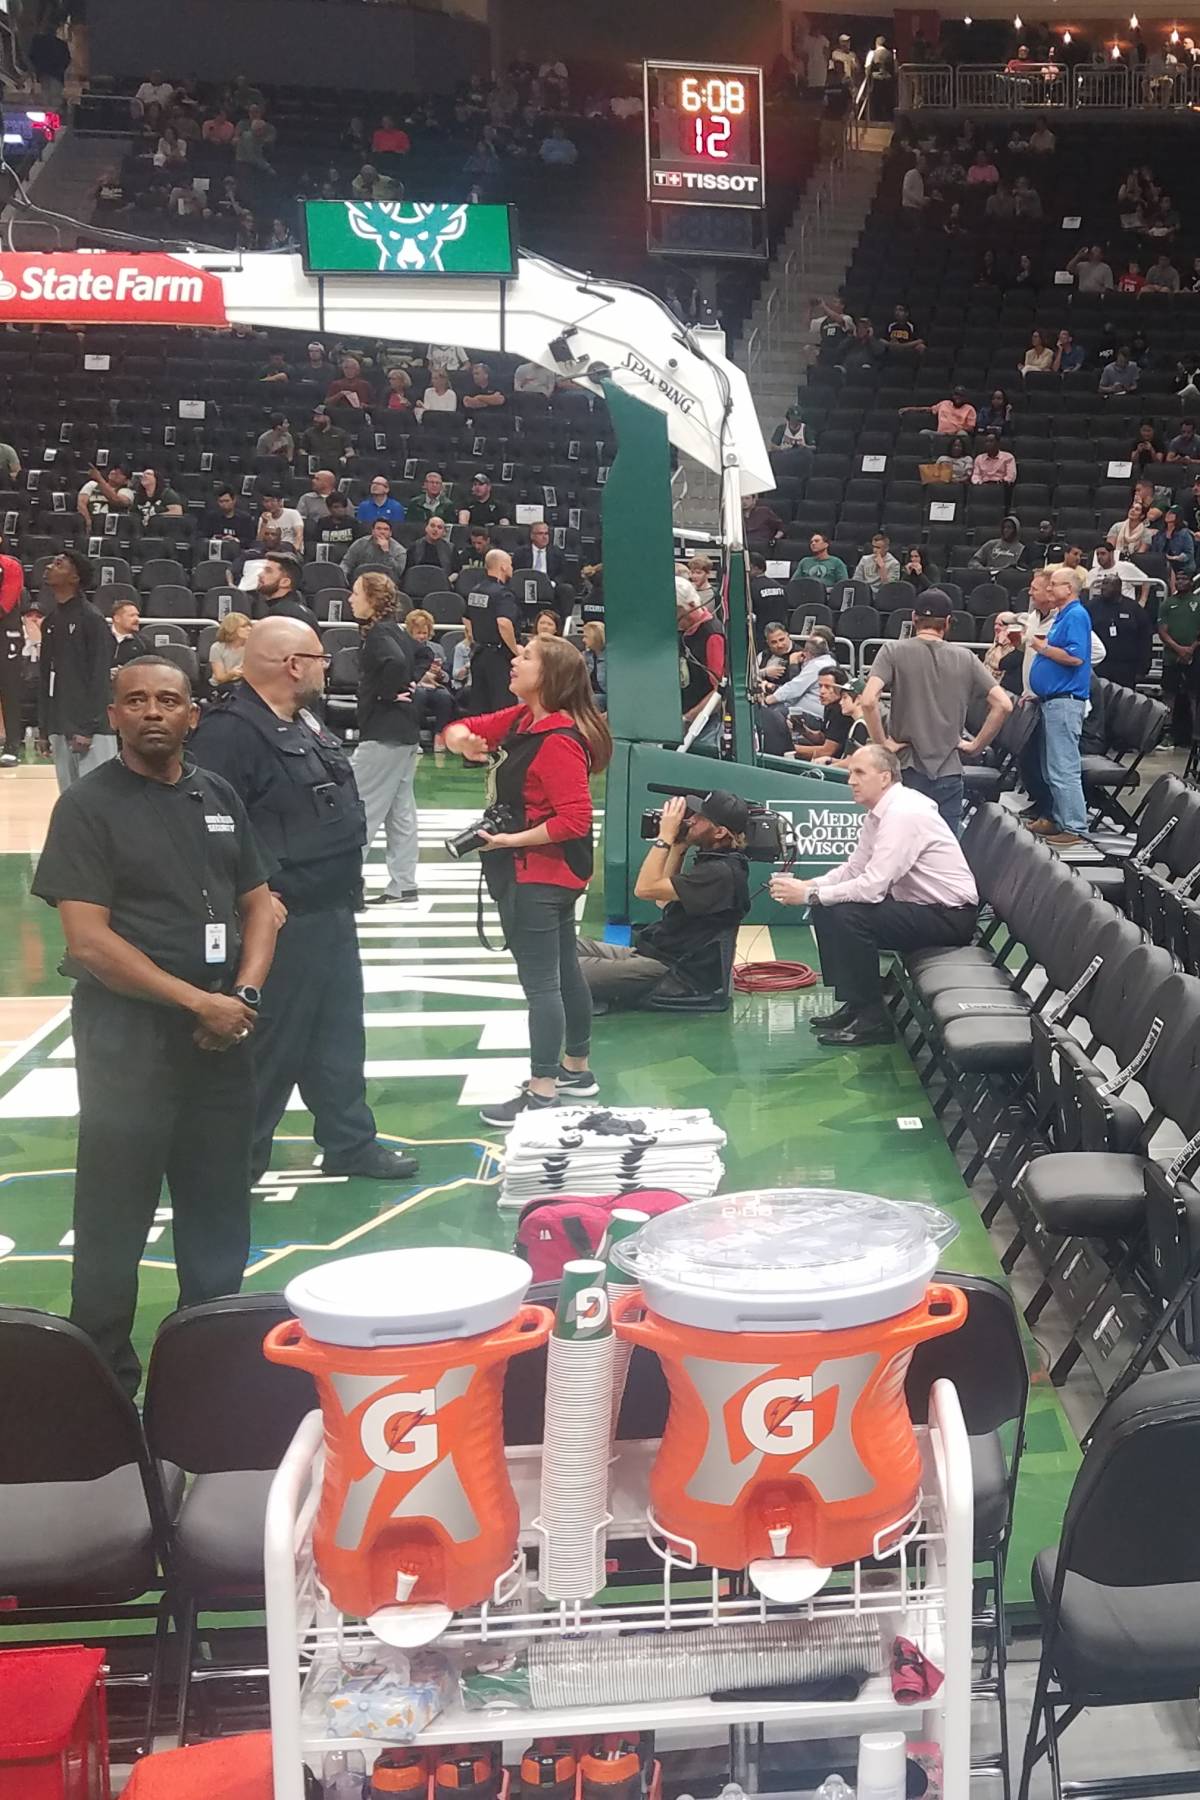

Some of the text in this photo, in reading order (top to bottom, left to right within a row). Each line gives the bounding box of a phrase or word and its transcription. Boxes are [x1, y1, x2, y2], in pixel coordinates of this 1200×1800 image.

[682, 78, 745, 114] 6:08
[695, 115, 731, 158] 12
[683, 172, 758, 191] TISSOT
[575, 1287, 608, 1329] G
[361, 1388, 439, 1472] G
[741, 1375, 814, 1455] G
